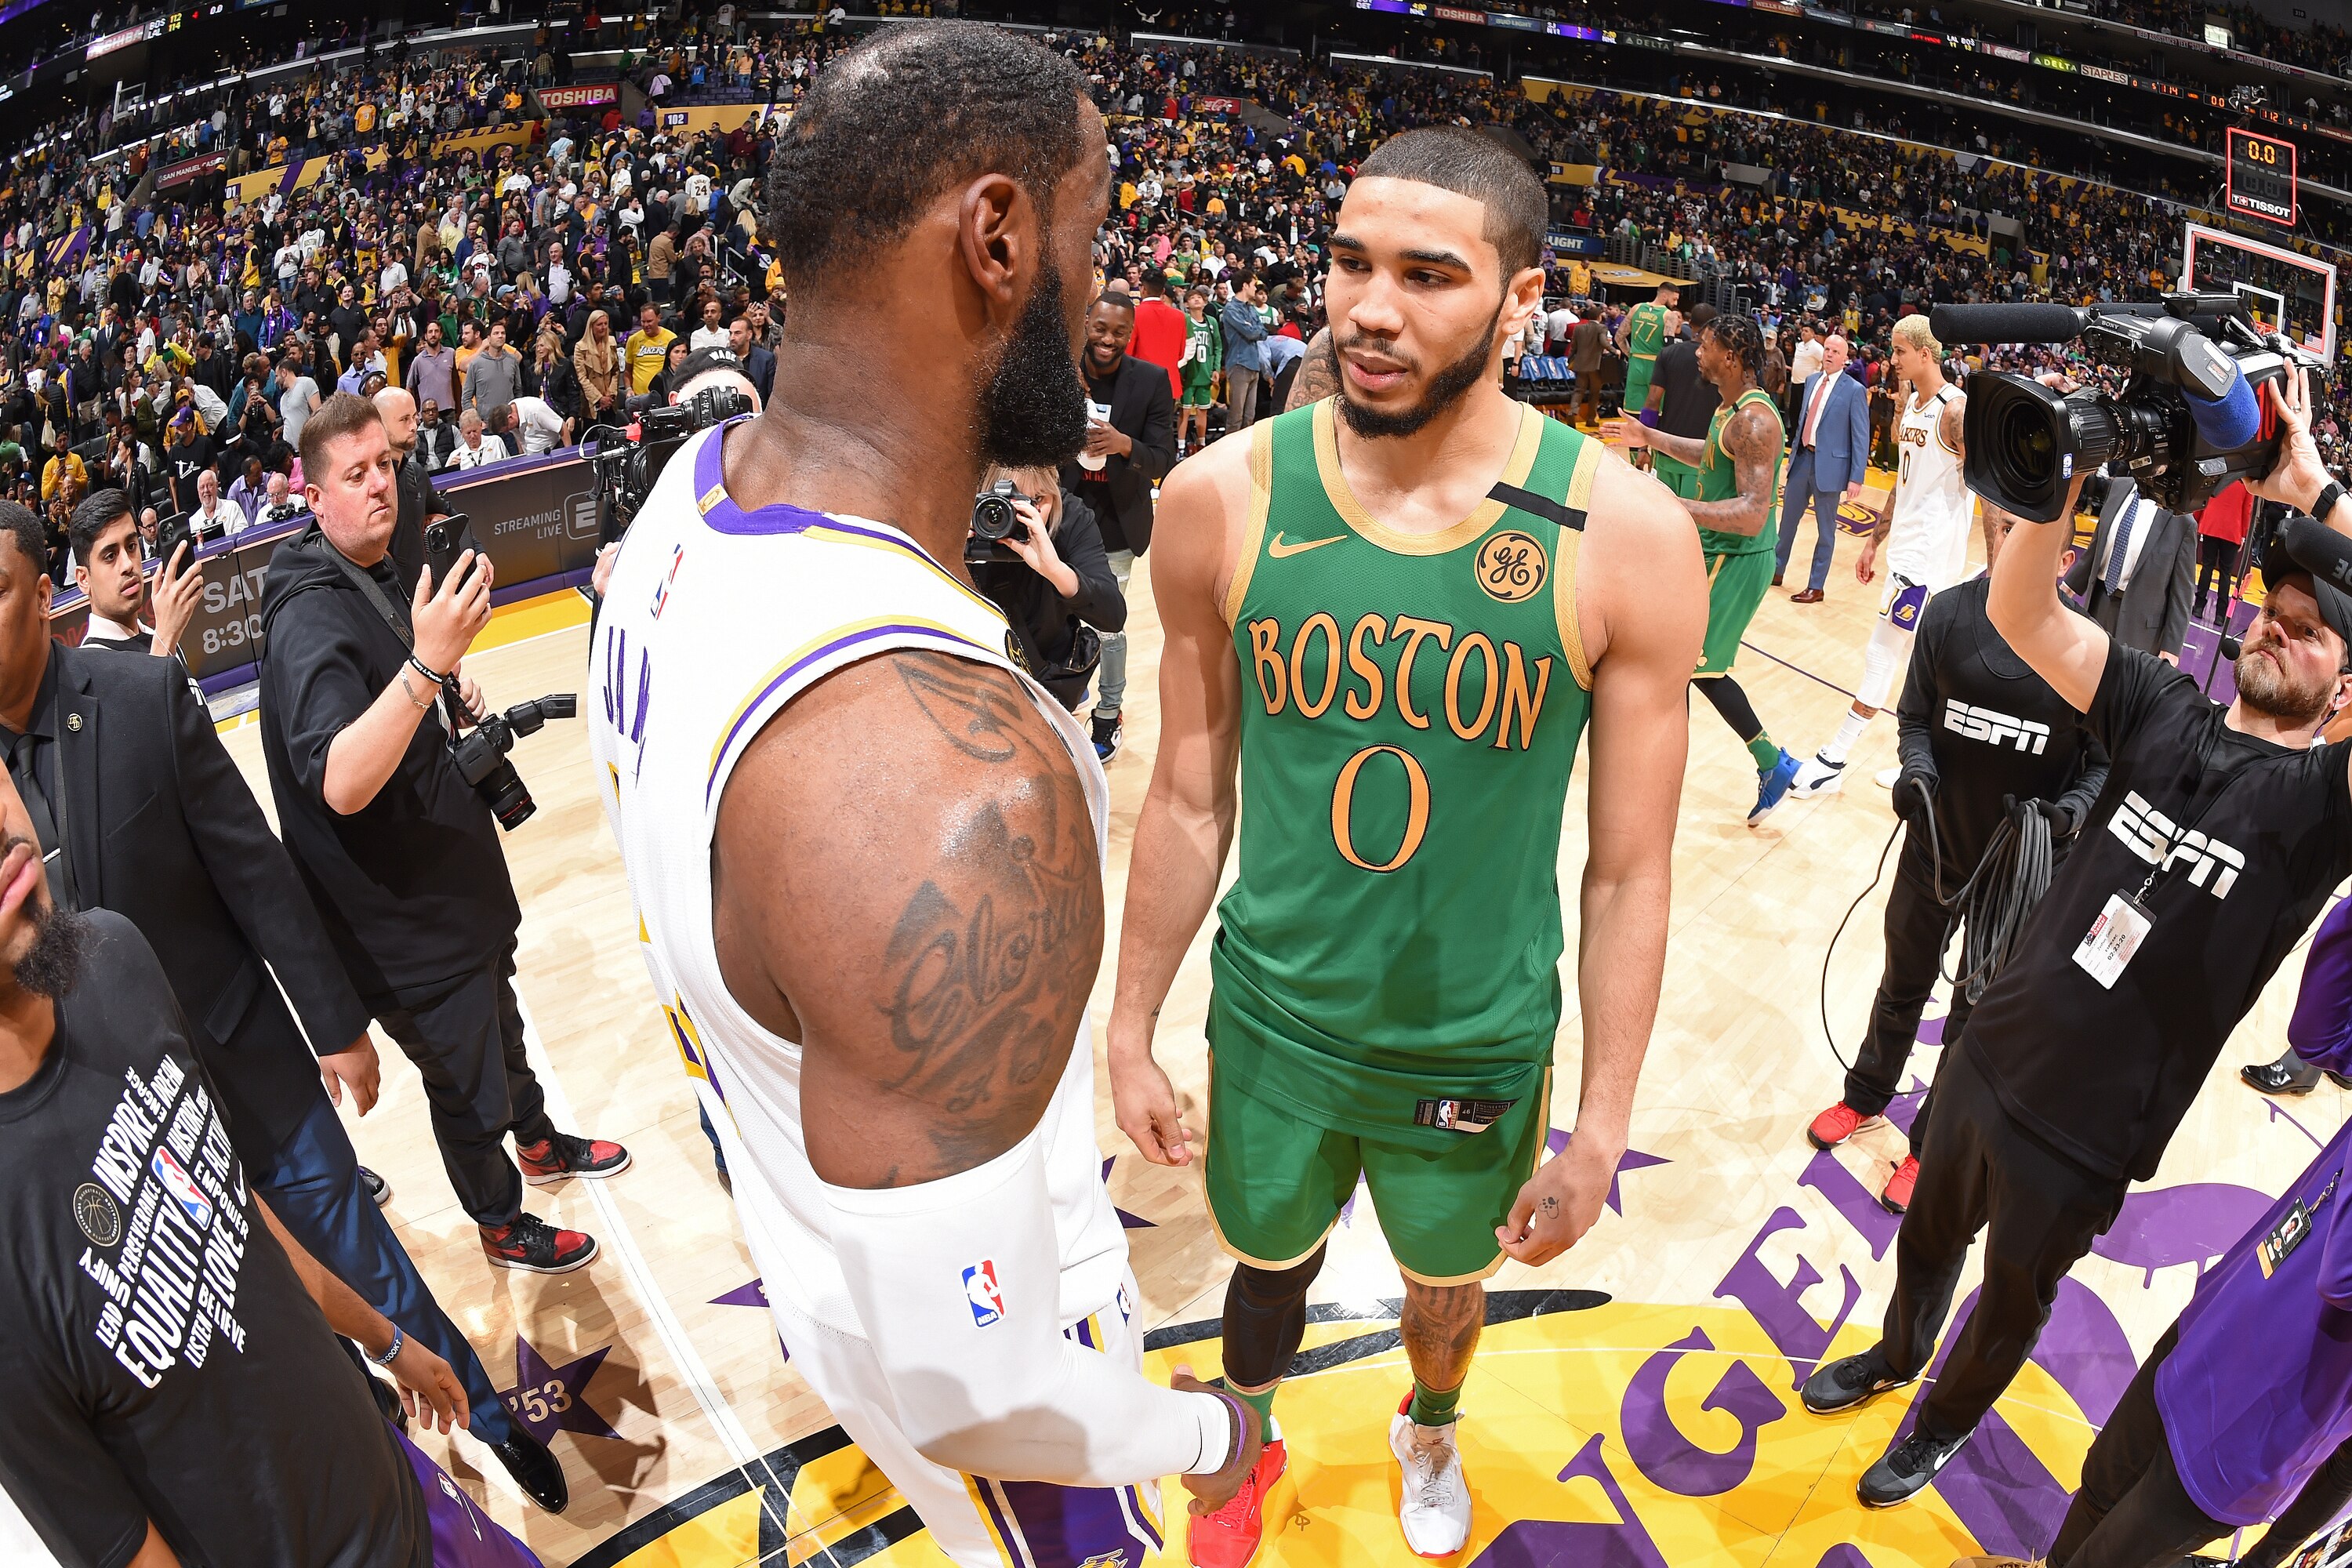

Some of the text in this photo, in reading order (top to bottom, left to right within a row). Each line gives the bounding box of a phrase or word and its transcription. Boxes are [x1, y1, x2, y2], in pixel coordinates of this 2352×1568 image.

[168, 22, 181, 32] 114
[169, 13, 182, 24] 112
[1435, 7, 1485, 24] TOSHIBA
[1635, 39, 1670, 50] DELTA
[2178, 38, 2189, 49] TEXT
[2270, 61, 2291, 74] 69050
[2044, 58, 2078, 72] DELTA
[2082, 66, 2126, 85] STAPLES
[541, 88, 615, 106] TOSHIBA
[2161, 85, 2179, 96] 114
[668, 114, 684, 125] 102
[2263, 110, 2278, 122] 112
[2249, 141, 2275, 165] 0.0
[163, 172, 176, 181] SAN
[176, 165, 201, 176] MANUEL
[225, 186, 237, 199] 01
[695, 185, 707, 196] 24
[2249, 198, 2291, 218] TISSOT
[1548, 235, 1584, 249] LIGHT
[1634, 320, 1658, 343] 77
[2102, 320, 2119, 329] SONY
[1196, 345, 1207, 362] 0
[1903, 450, 1910, 487] 0
[494, 510, 561, 535] STREAMING
[538, 523, 561, 539] LIVE
[202, 615, 263, 654] 8:30
[1247, 611, 1553, 752] BOSTON
[1943, 698, 2051, 756] ESPN
[1331, 742, 1432, 874] 0
[2107, 789, 2246, 900] ESPN
[2093, 917, 2107, 935] Center
[2107, 935, 2126, 960] 02-23-20
[125, 1066, 168, 1123] ENGAGE
[150, 1054, 185, 1109] DREAM
[166, 1092, 205, 1165] HISTORY
[93, 1088, 158, 1205] INSPIRE
[194, 1160, 249, 1240] EMPOWER
[118, 1174, 162, 1283] PERSEVERANCE
[202, 1213, 245, 1309] LOVE
[78, 1247, 131, 1308] UNIFY
[115, 1192, 202, 1388] EQUALITY
[95, 1301, 124, 1350] LEAD
[198, 1283, 246, 1353] BELIEVE
[977, 1311, 997, 1325] NBA
[183, 1309, 213, 1369] LISTEN
